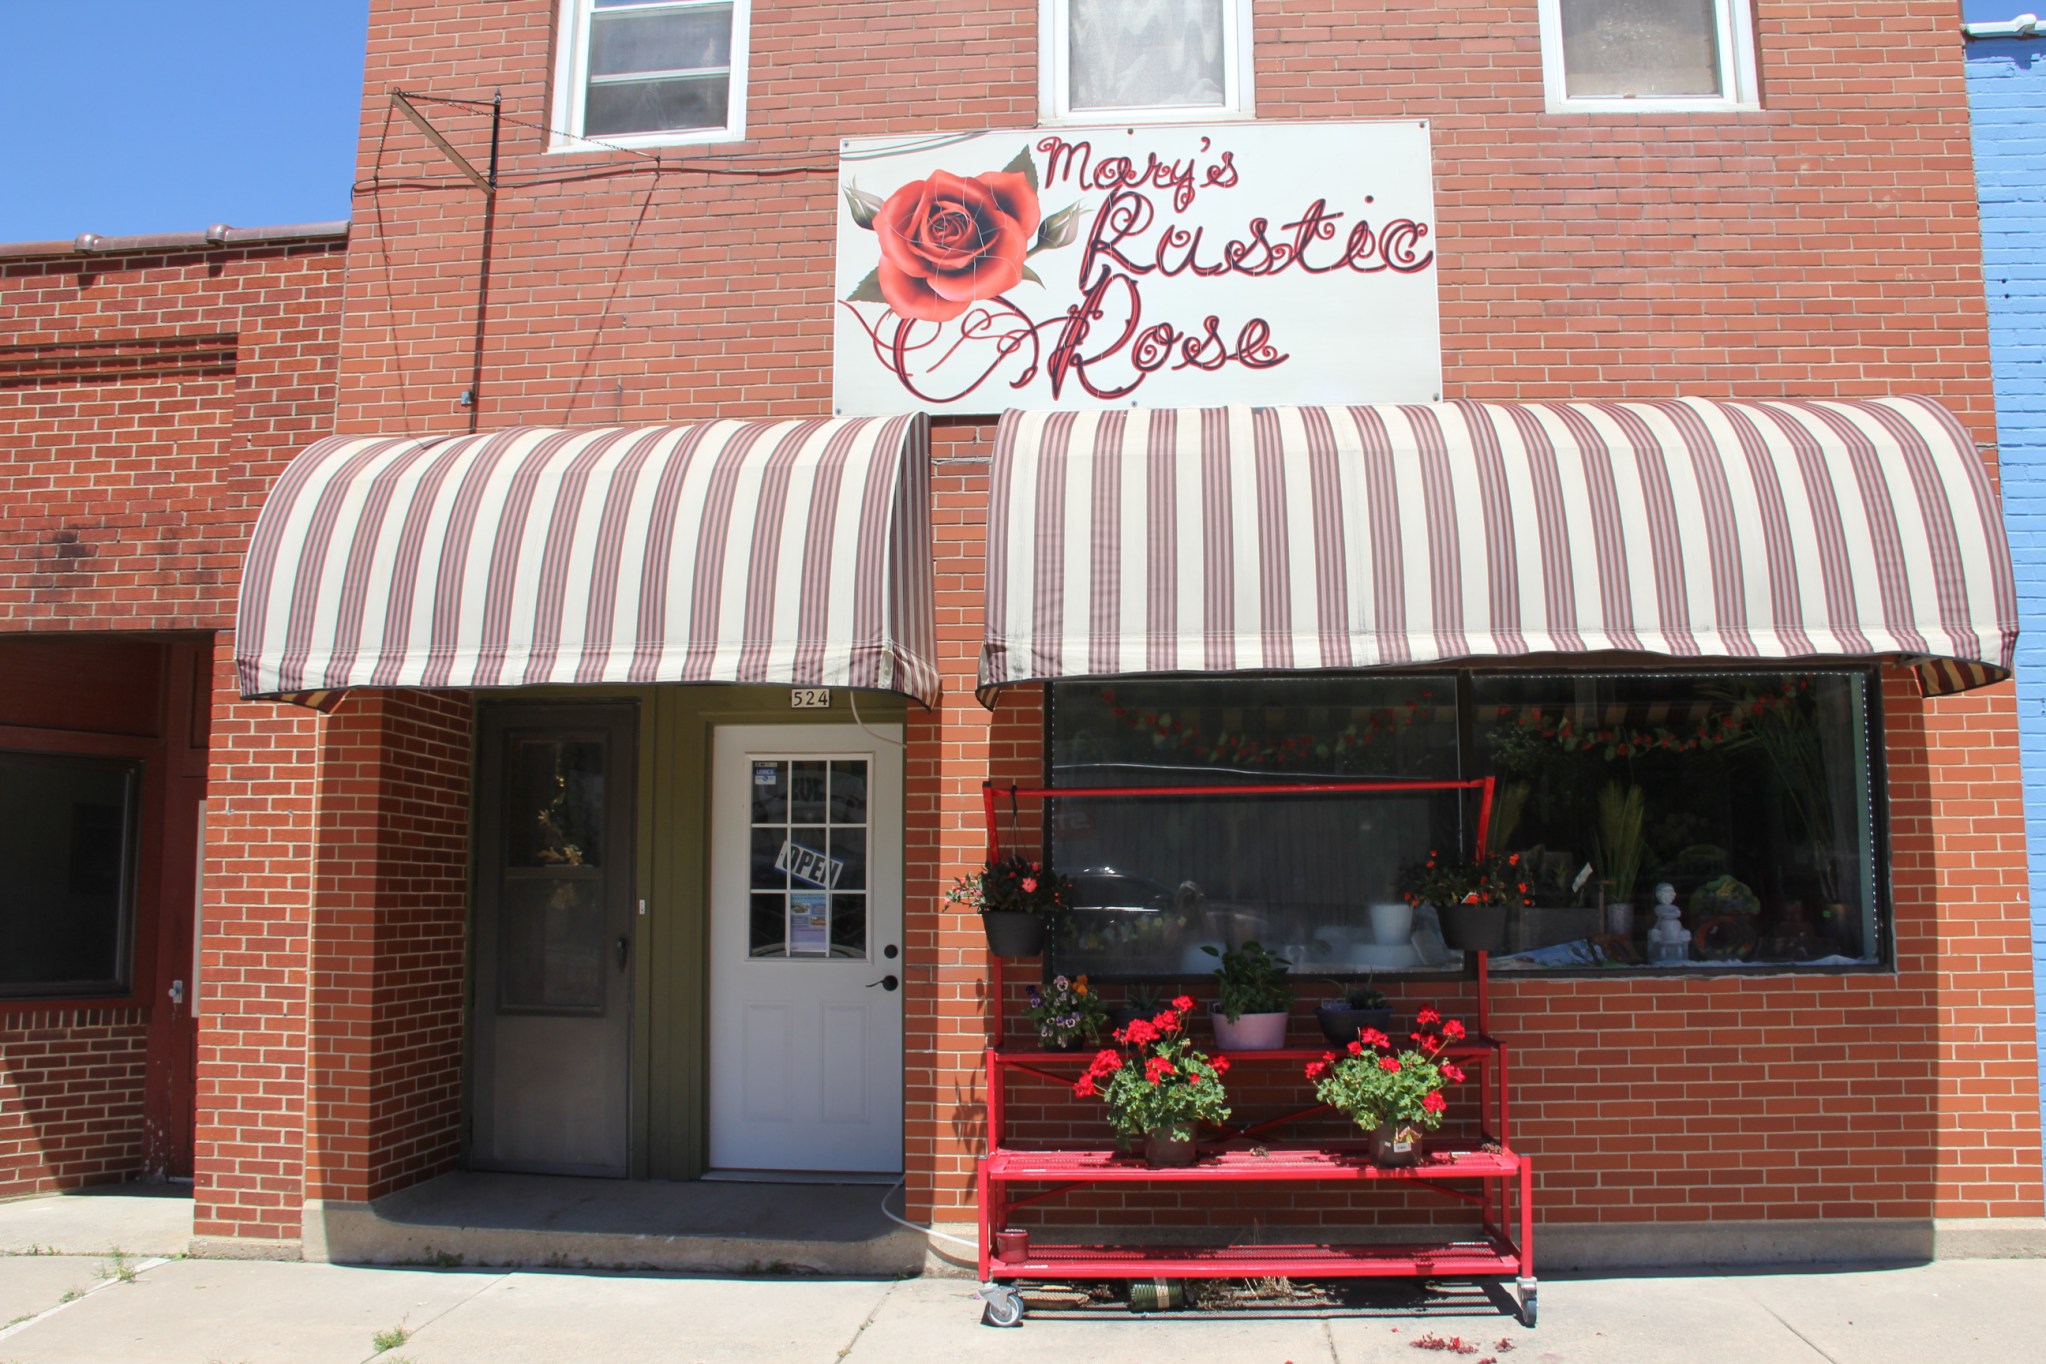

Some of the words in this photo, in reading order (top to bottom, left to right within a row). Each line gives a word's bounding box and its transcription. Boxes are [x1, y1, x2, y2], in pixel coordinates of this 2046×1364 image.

[1036, 136, 1238, 212] Mary's
[1079, 185, 1433, 291] Rustic
[1047, 264, 1289, 400] Rose
[793, 690, 828, 707] 524
[782, 844, 840, 888] OPEN
